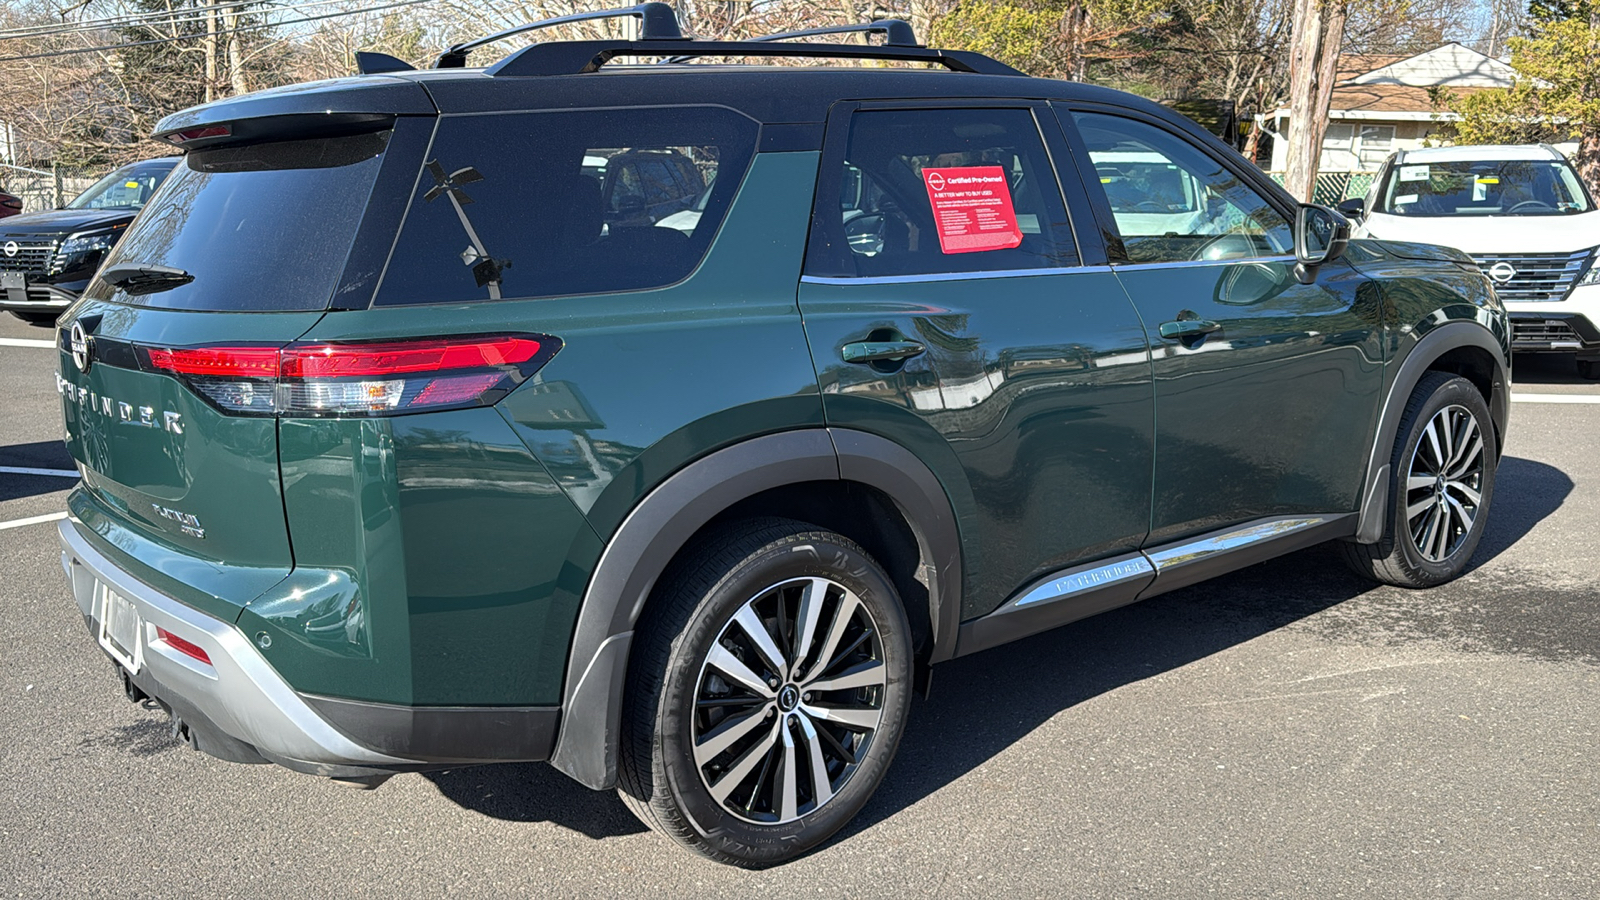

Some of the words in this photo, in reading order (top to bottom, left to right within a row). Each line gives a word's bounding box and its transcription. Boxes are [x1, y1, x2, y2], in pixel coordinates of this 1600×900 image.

[947, 177, 972, 185] Certified
[972, 175, 1003, 184] Pre-Owned
[151, 503, 201, 528] PLATINUM
